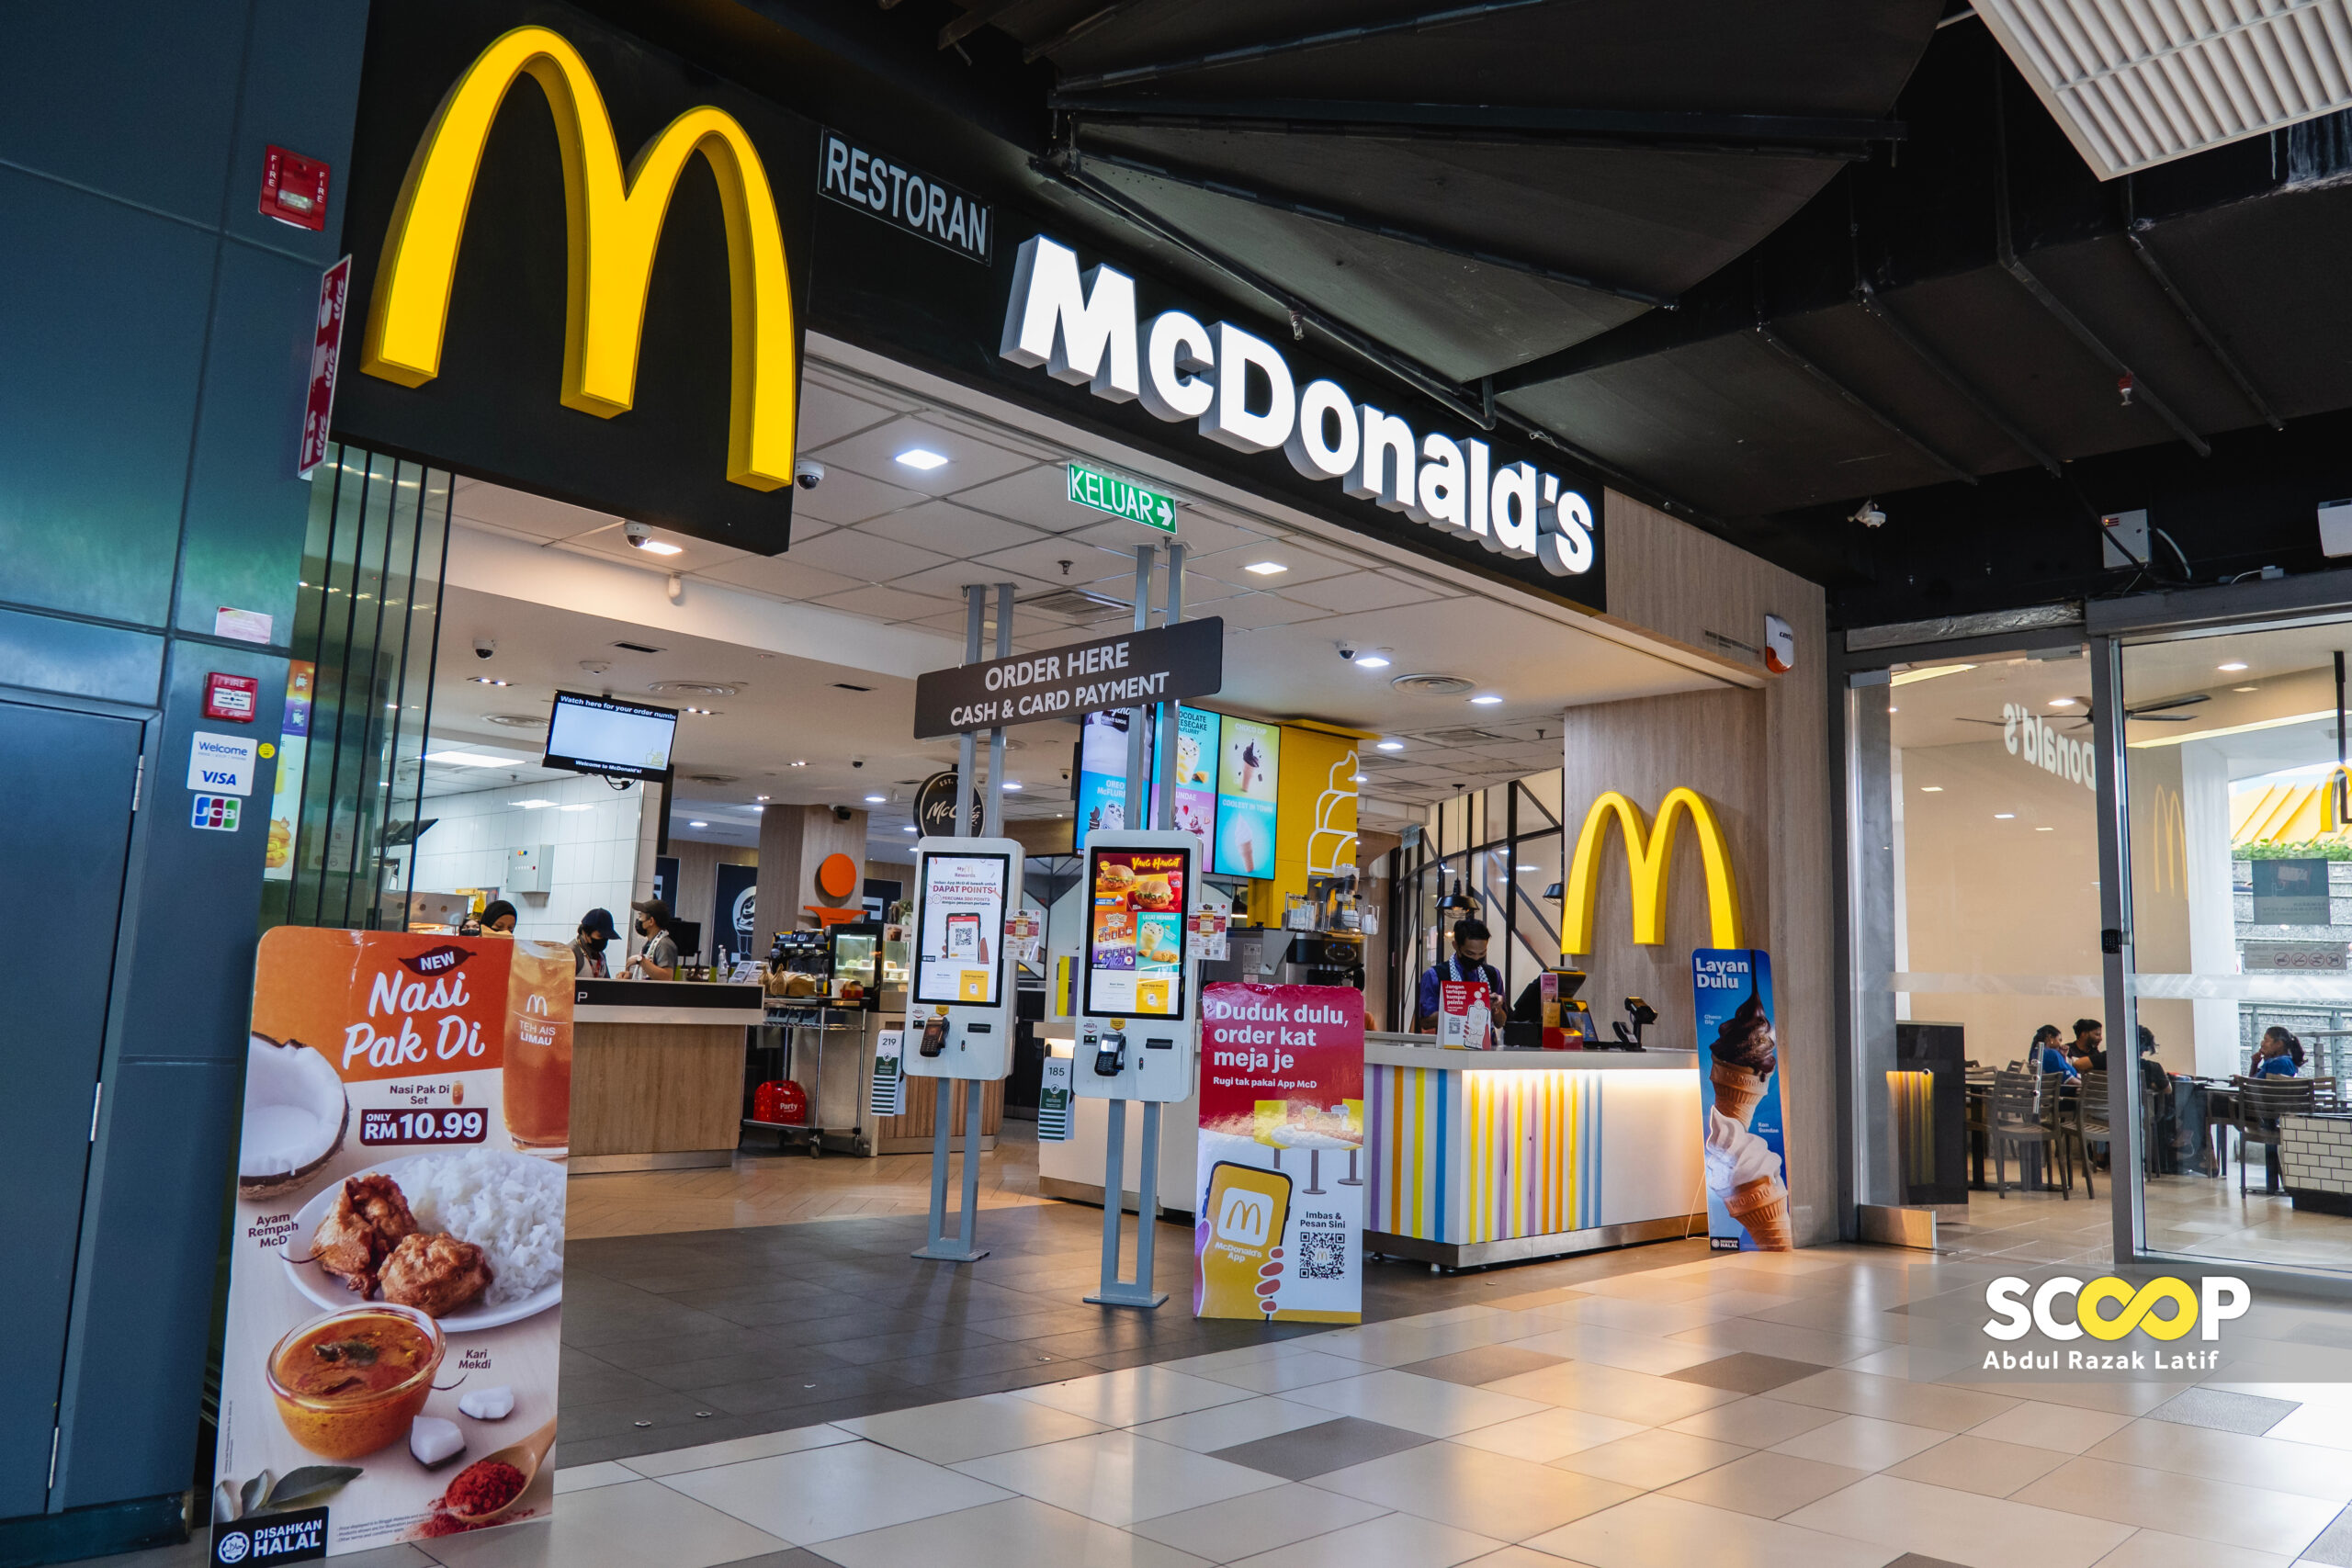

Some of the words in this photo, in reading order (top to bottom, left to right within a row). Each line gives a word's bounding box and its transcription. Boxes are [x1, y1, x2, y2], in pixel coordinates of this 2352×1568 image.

[269, 154, 277, 187] FIRE
[316, 171, 325, 203] FIRE
[826, 137, 987, 256] RESTORAN
[1001, 234, 1593, 577] McDonald's
[1070, 467, 1154, 523] KELUAR
[985, 656, 1059, 691] ORDER
[1068, 642, 1130, 677] HERE
[224, 679, 245, 687] FIRE
[560, 695, 584, 705] Watch
[585, 700, 602, 708] here
[616, 705, 632, 713] your
[633, 707, 652, 716] order
[951, 700, 997, 727] CASH
[1001, 699, 1014, 718] &
[1018, 690, 1069, 716] CARD
[1075, 671, 1170, 706] PAYMENT
[1179, 711, 1206, 723] OCOLATE
[1178, 719, 1207, 731] ESECAKE
[1235, 722, 1256, 733] CHOCO
[1257, 727, 1267, 735] DIP
[199, 741, 248, 756] Welcome
[575, 760, 602, 769] Welcome
[201, 770, 237, 785] VISA
[939, 778, 954, 787] EST.
[1106, 779, 1125, 789] OREO
[1097, 786, 1126, 797] McFLUR
[1176, 791, 1197, 801] UNDAE
[1223, 798, 1249, 808] COOLEST
[933, 885, 960, 893] DAPAT
[419, 951, 456, 972] NEW
[1695, 957, 1748, 976] Layan
[1697, 974, 1739, 989] Dulu
[368, 970, 470, 1018] Nasi
[1216, 1001, 1289, 1022] Duduk
[1294, 1004, 1349, 1027] dulu,
[519, 1020, 537, 1034] TEH
[538, 1024, 556, 1036] AIS
[520, 1032, 553, 1046] LIMAU
[1214, 1025, 1275, 1044] order
[1280, 1026, 1317, 1046] kat
[342, 1016, 429, 1070] Pak
[435, 1018, 486, 1061] Di
[1214, 1047, 1269, 1072] meja
[1272, 1048, 1295, 1074] je
[1048, 1066, 1065, 1076] 185
[390, 1085, 414, 1095] Nasi
[416, 1085, 437, 1095] Pak
[439, 1084, 450, 1095] Di
[1213, 1077, 1234, 1087] Rugi
[1235, 1077, 1250, 1086] tak
[1250, 1078, 1276, 1089] pakai
[1277, 1080, 1295, 1089] App
[1296, 1080, 1317, 1089] McD
[410, 1095, 428, 1105] Set
[779, 1102, 798, 1112] Party
[367, 1112, 391, 1122] ONLY
[365, 1122, 398, 1140] RM
[400, 1111, 482, 1139] 10.99
[255, 1212, 290, 1226] Ayam
[1306, 1212, 1333, 1220] Imbas
[1335, 1212, 1341, 1220] &
[248, 1222, 300, 1240] Rempah
[1300, 1220, 1327, 1228] Pesan
[1329, 1220, 1346, 1228] Sini
[1215, 1241, 1262, 1258] McDonald's
[1227, 1252, 1246, 1263] App
[465, 1348, 488, 1359] Kari
[458, 1358, 492, 1371] Mekdi
[254, 1519, 322, 1540] DISAHKAN
[254, 1531, 321, 1558] HALAL
